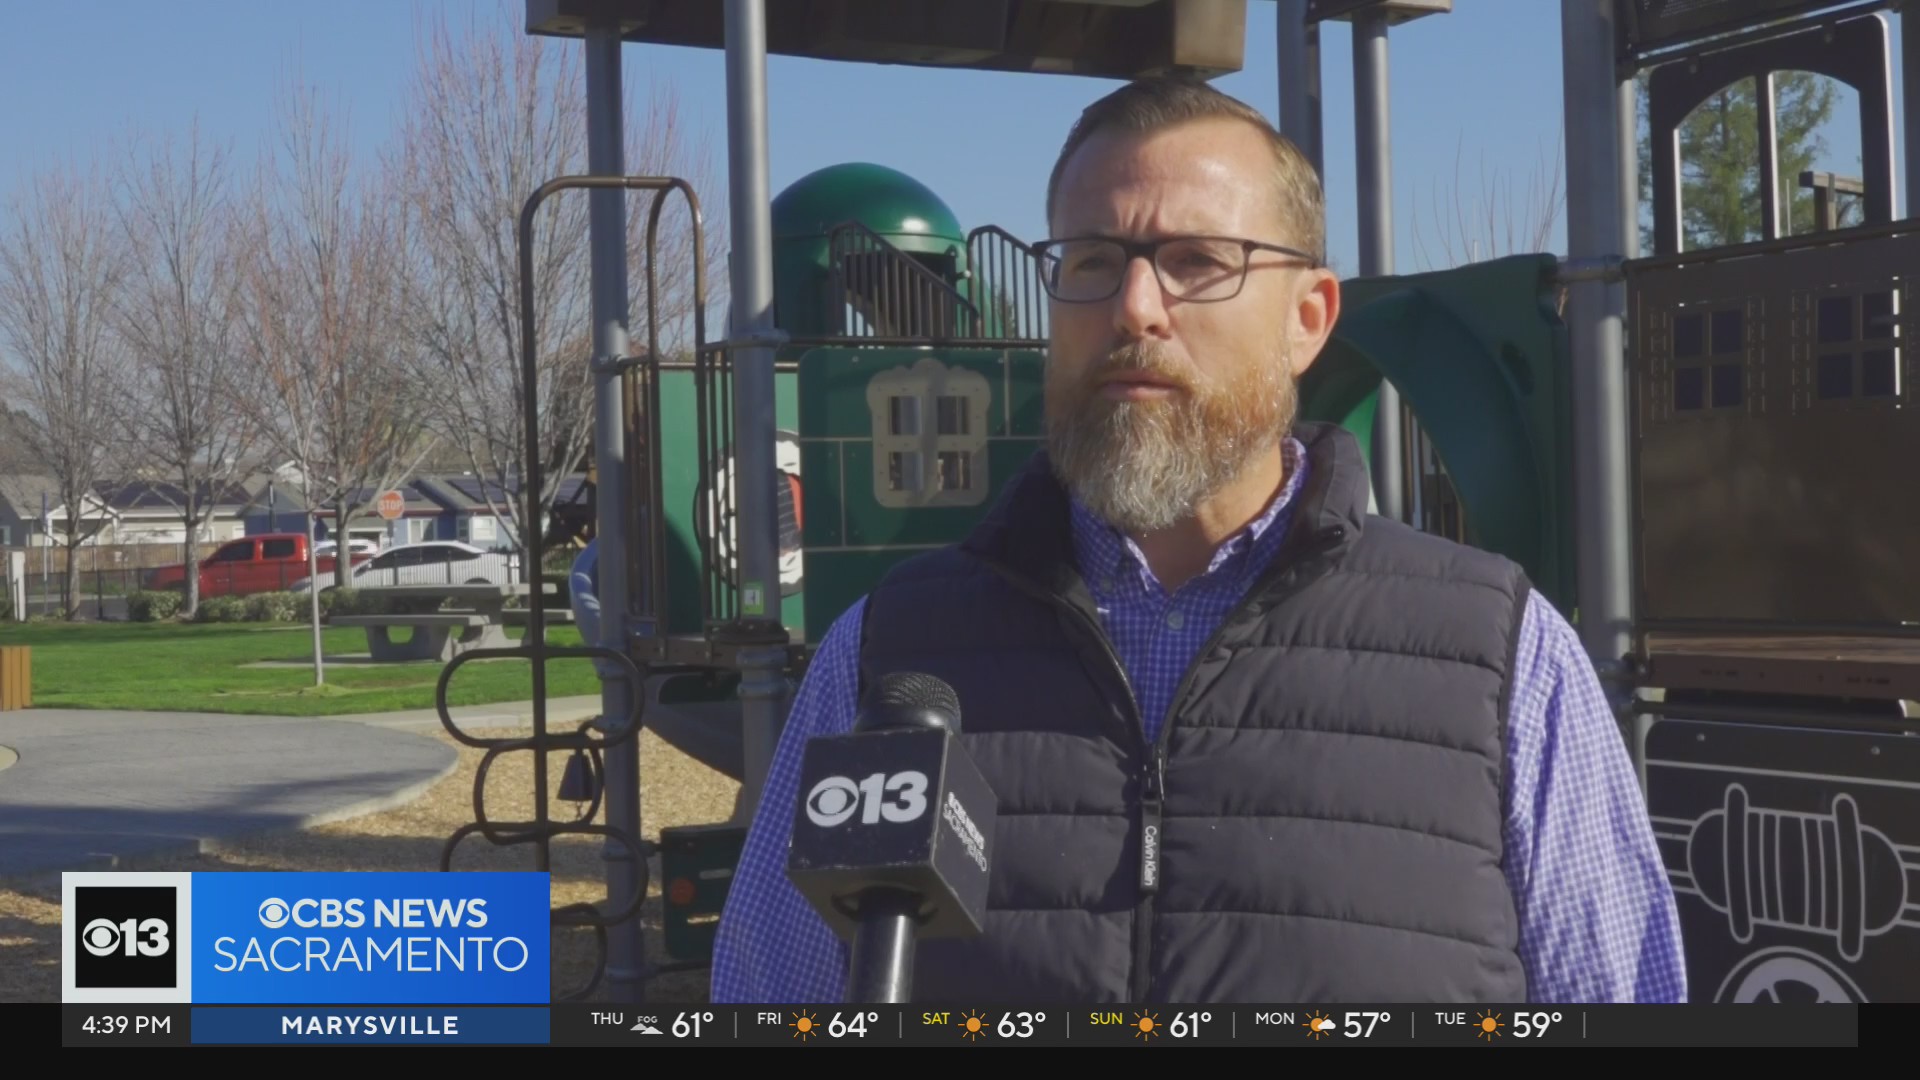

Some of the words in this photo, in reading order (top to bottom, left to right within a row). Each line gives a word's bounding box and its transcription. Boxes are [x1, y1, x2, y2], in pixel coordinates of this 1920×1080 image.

[379, 499, 403, 512] STOP
[859, 770, 929, 824] 13
[1145, 825, 1157, 860] Calvin
[1144, 860, 1156, 886] Klein
